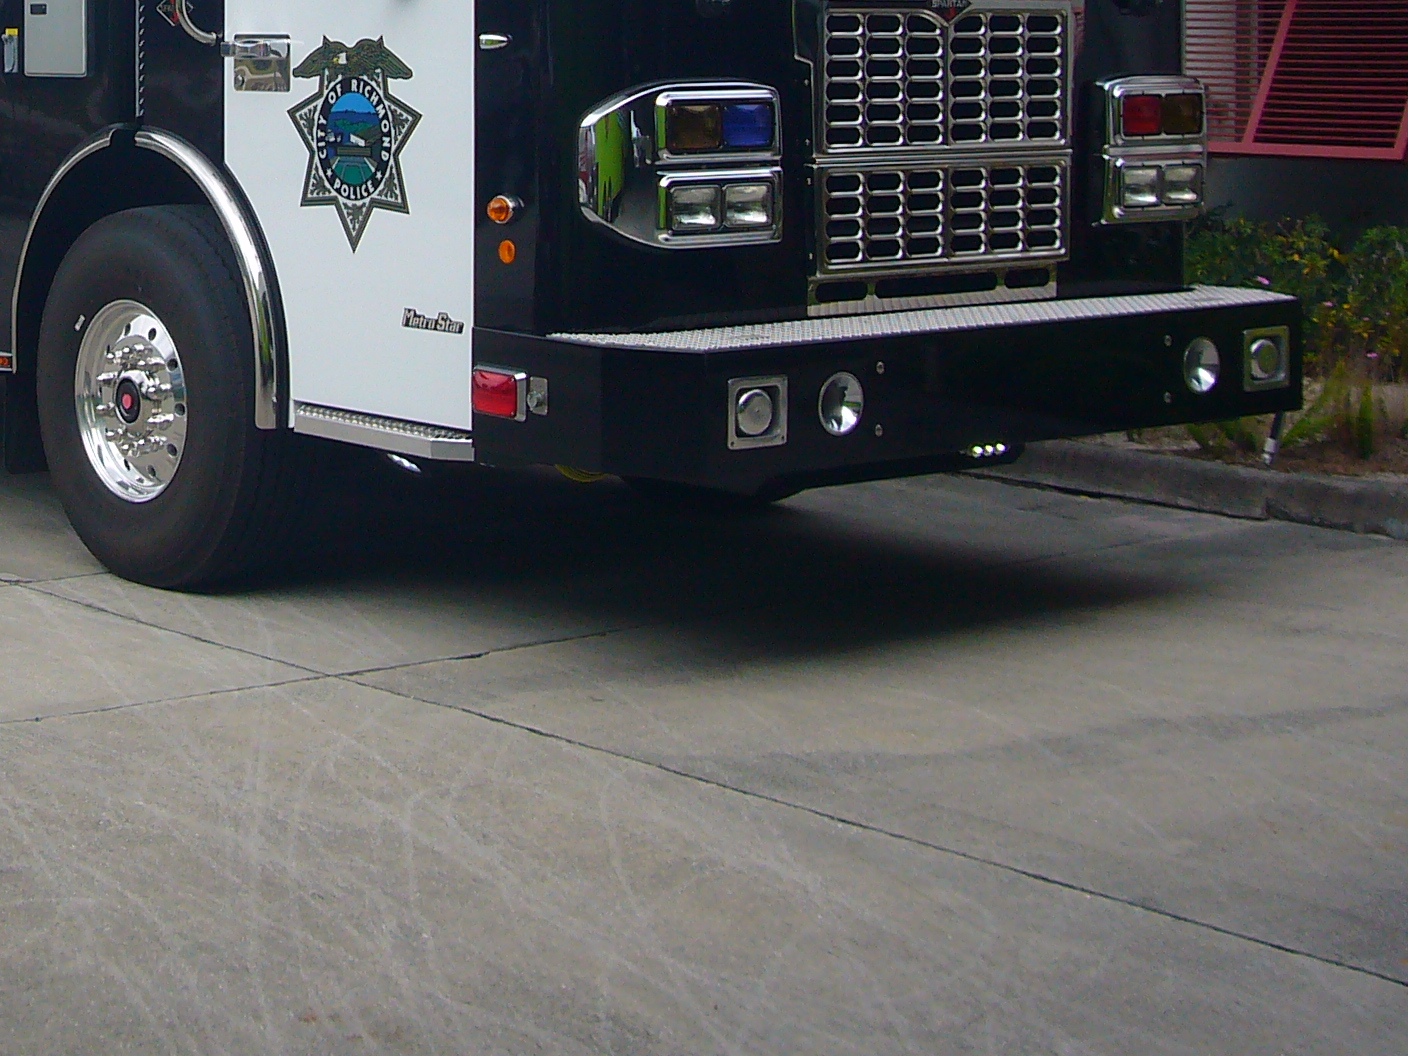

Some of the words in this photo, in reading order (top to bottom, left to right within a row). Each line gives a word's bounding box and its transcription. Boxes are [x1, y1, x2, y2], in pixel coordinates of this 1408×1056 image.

[318, 114, 328, 160] CITY
[327, 83, 343, 105] OF
[350, 78, 392, 162] RICHMOND
[333, 179, 375, 200] POLICE
